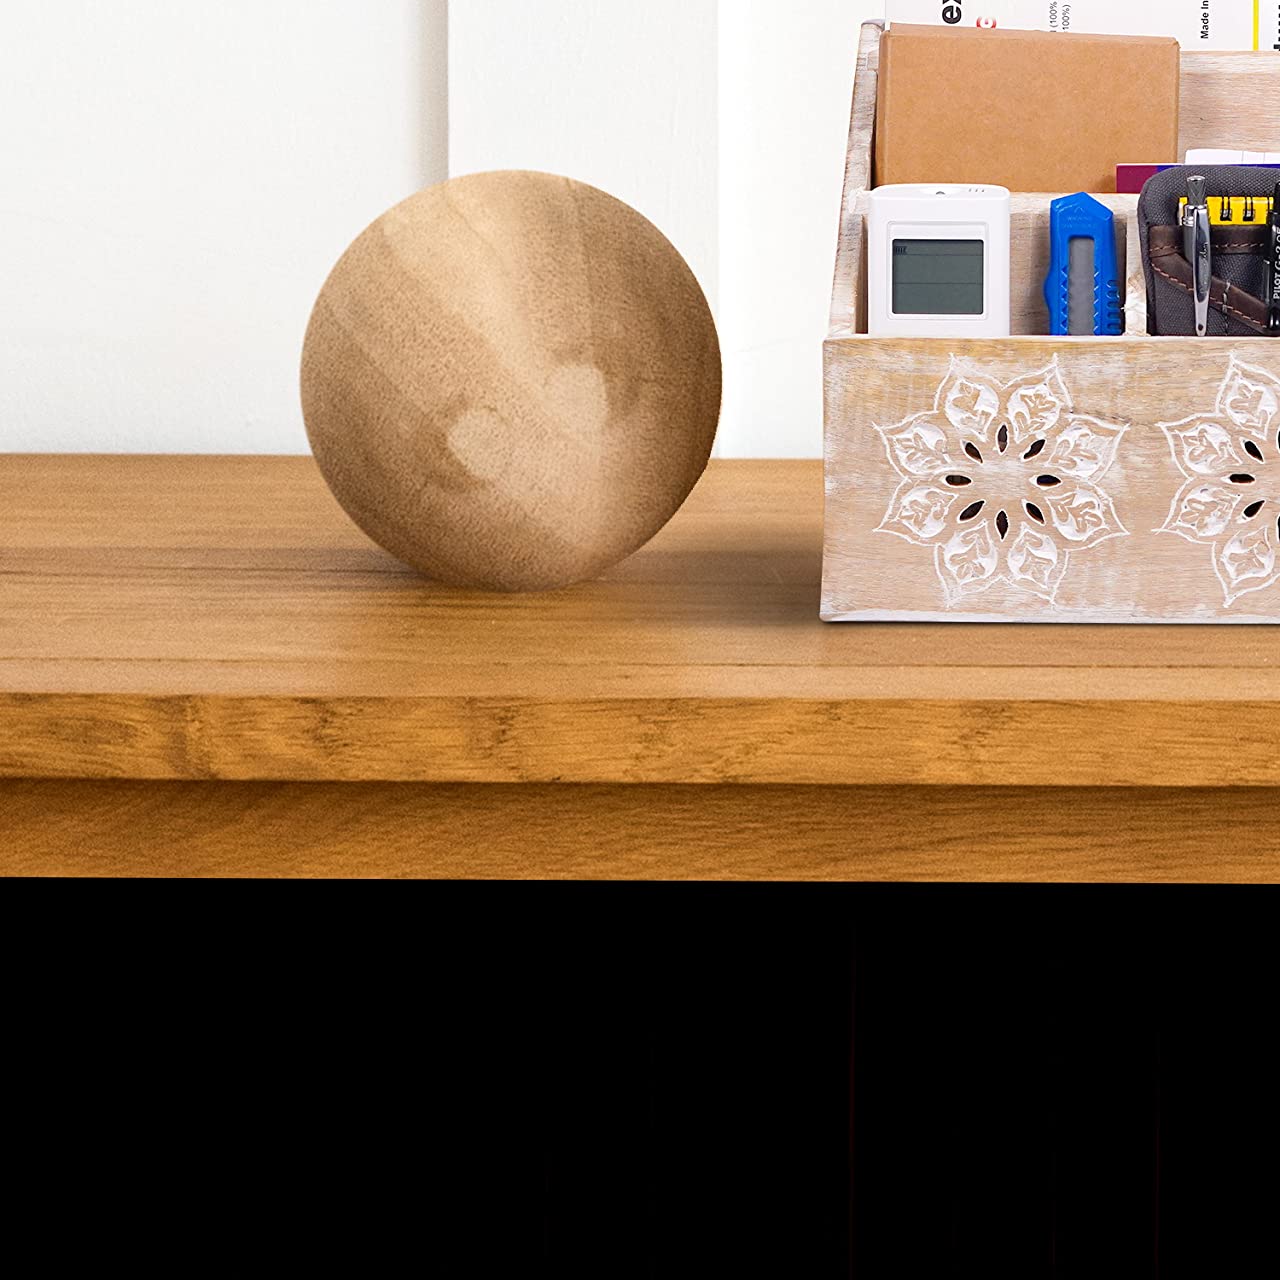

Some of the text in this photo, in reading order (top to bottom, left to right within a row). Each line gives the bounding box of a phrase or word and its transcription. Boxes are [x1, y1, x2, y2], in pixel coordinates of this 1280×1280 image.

[1049, 1, 1058, 28] (100%
[1200, 0, 1209, 40] Made In
